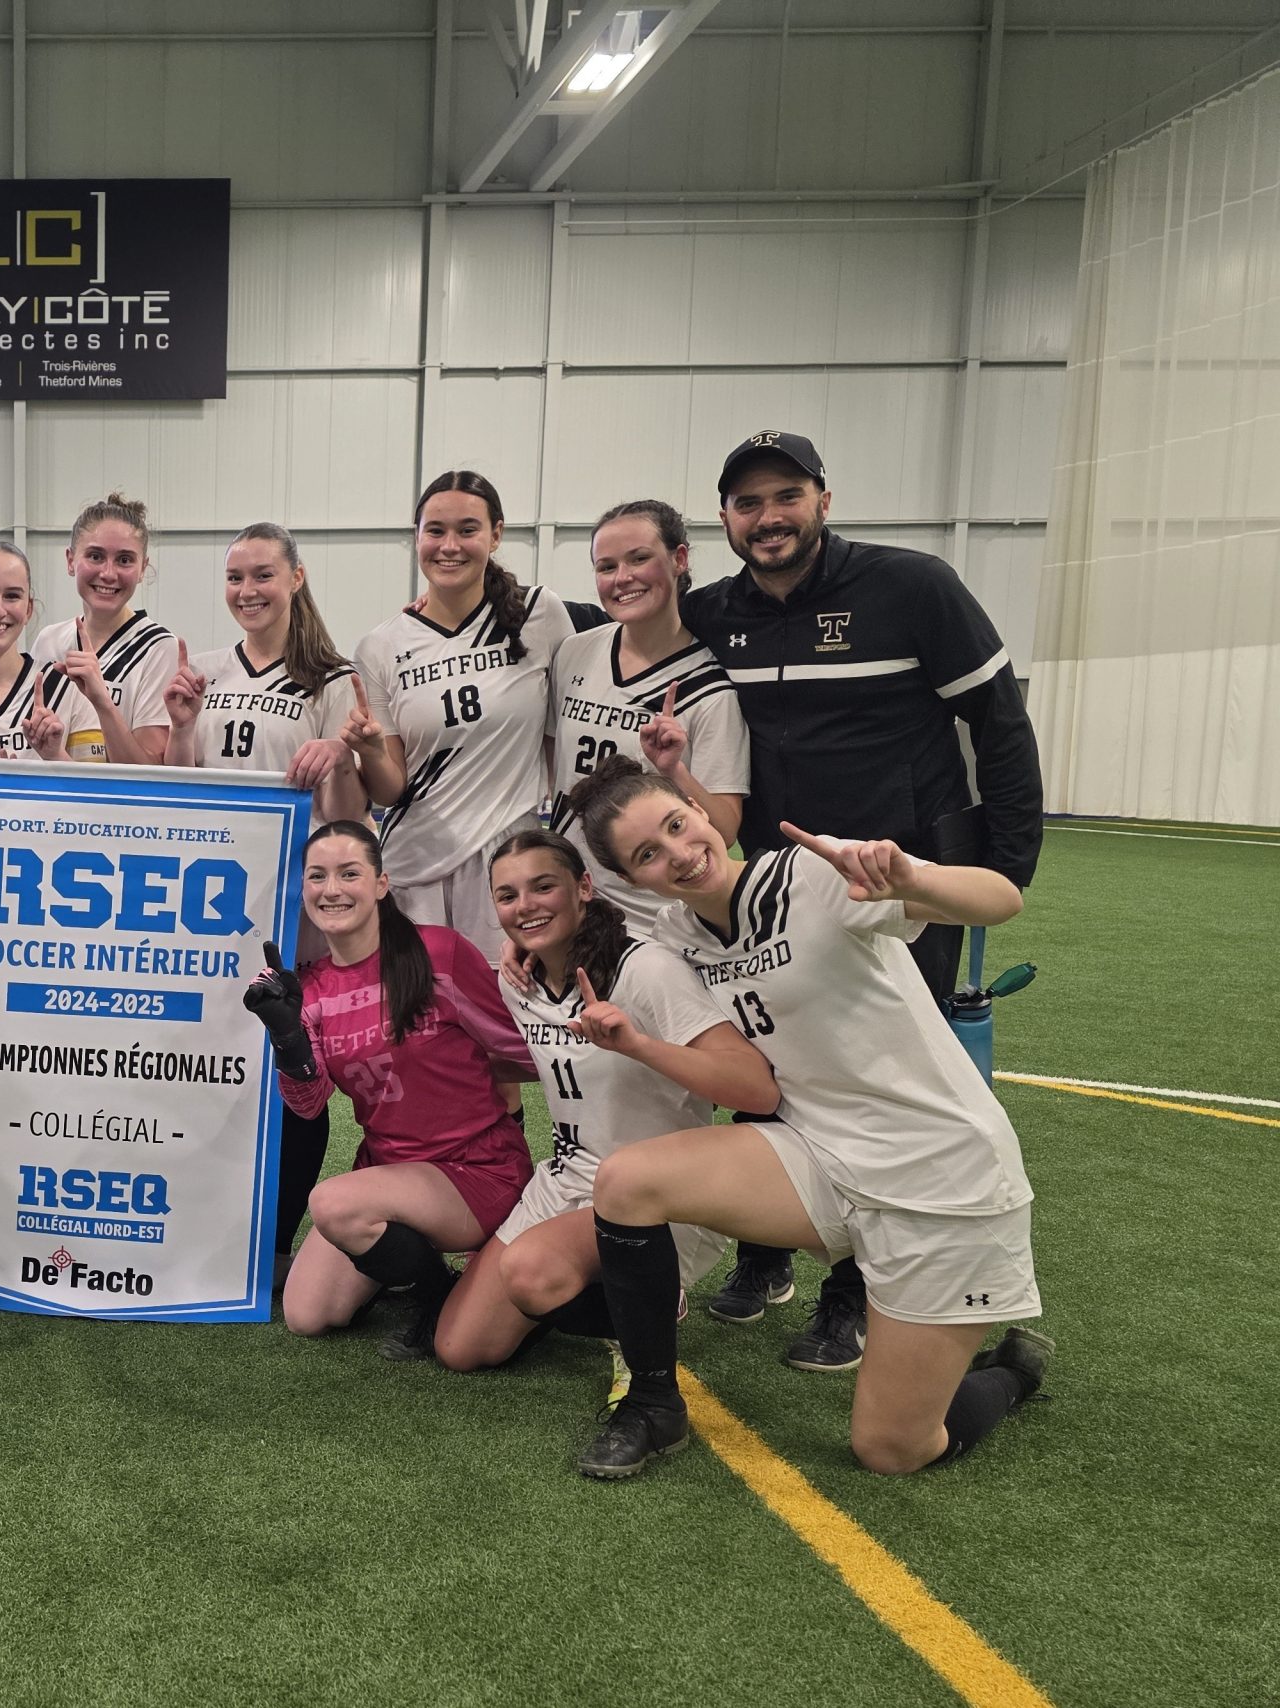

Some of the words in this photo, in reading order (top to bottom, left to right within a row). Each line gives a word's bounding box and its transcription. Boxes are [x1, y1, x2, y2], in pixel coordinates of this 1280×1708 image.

[119, 328, 170, 350] inc
[38, 375, 86, 388] Thetford
[88, 375, 122, 388] Mines
[42, 359, 117, 373] Trois-Rivières
[816, 611, 852, 643] T
[204, 693, 303, 721] HETFORD
[440, 684, 483, 729] 18
[562, 696, 652, 733] THETFOR
[221, 720, 256, 758] 19
[52, 818, 163, 840] ÉDUCATION.
[166, 826, 236, 844] FIERTÉ.
[84, 938, 241, 978] INTÉRIEUR
[695, 939, 792, 991] THETFORD
[44, 988, 166, 1017] 2024-2025
[732, 990, 776, 1039] 13
[113, 1042, 247, 1085] RÉGIONALES
[344, 1053, 405, 1106] 25
[551, 1058, 584, 1100] 11
[29, 1109, 164, 1144] COLLÉGIAL
[17, 1165, 172, 1216] RSEQ
[17, 1214, 91, 1236] COLLÉGIAL
[93, 1223, 164, 1241] NORD-EST
[21, 1256, 59, 1287] De
[70, 1262, 154, 1297] Facto
